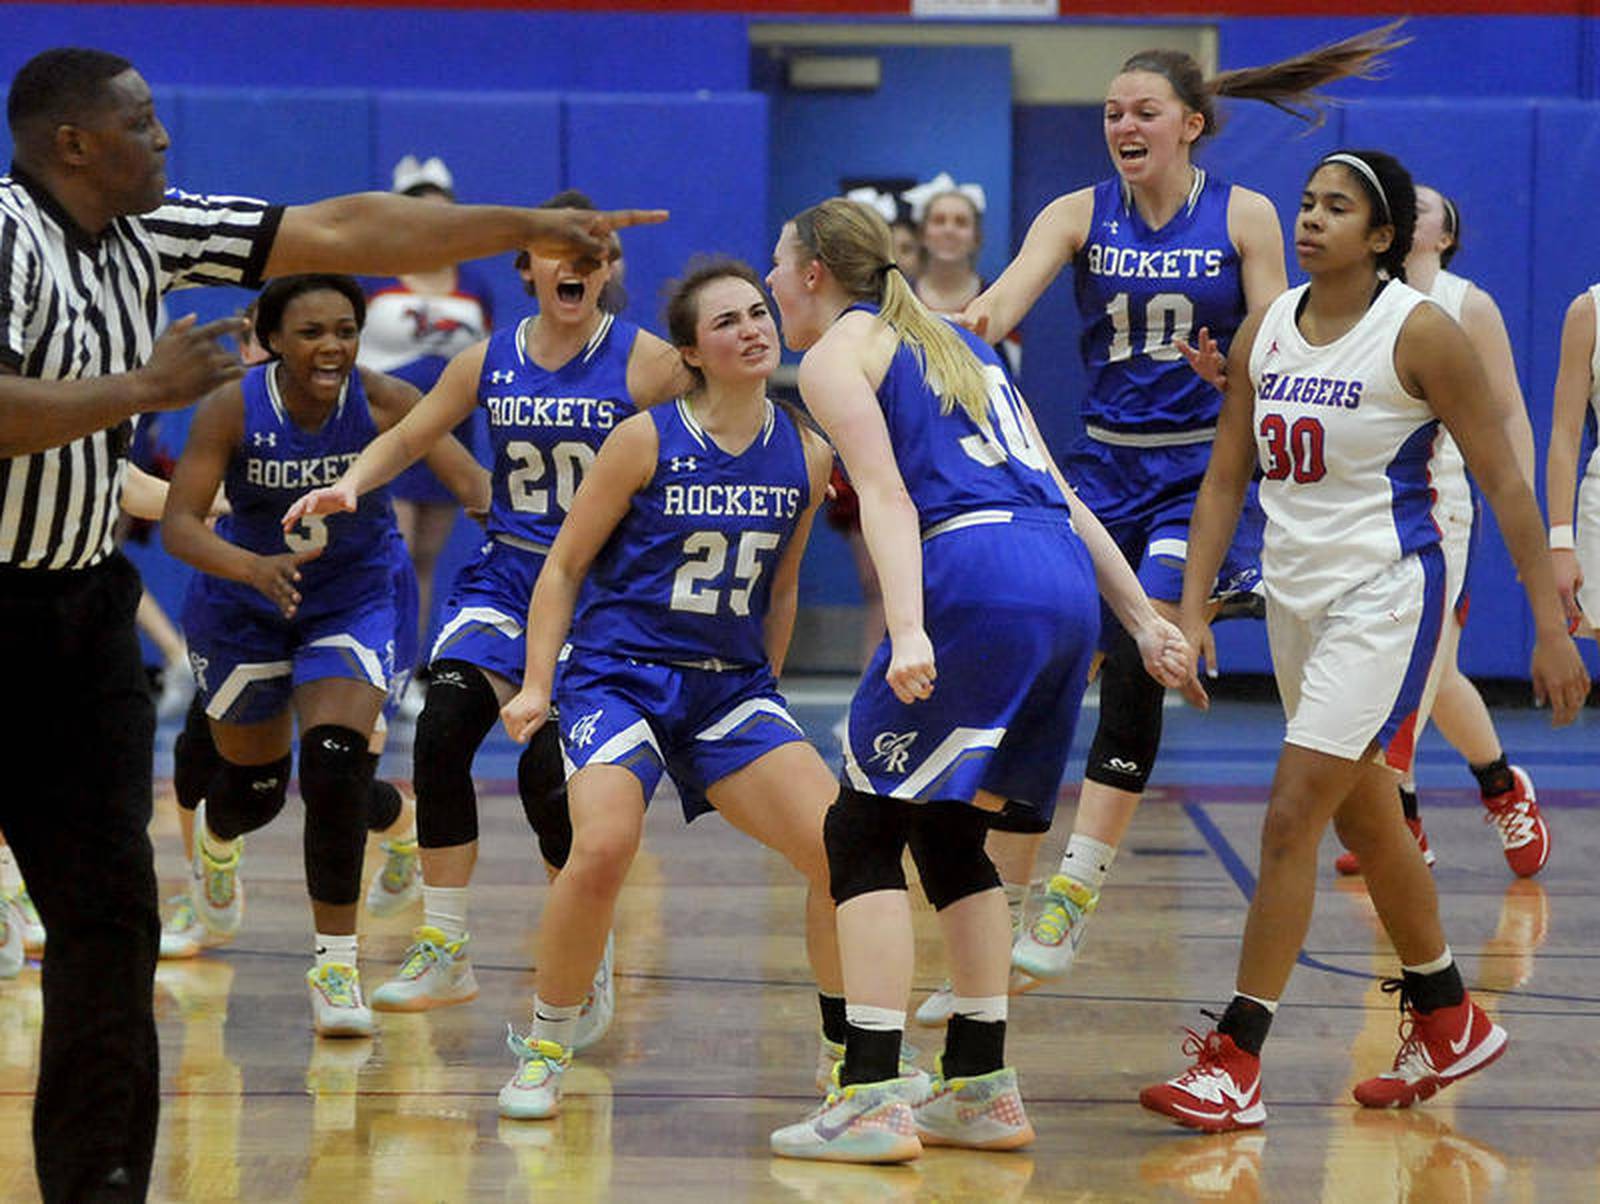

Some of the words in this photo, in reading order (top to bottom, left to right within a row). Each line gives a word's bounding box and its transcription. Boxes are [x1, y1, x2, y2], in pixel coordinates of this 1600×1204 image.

[1088, 244, 1223, 278] ROCKETS
[1106, 292, 1194, 362] 10
[487, 395, 615, 428] ROCKETS
[506, 441, 597, 514] 20
[1260, 413, 1327, 484] 30
[664, 484, 800, 519] ROCKETS
[670, 531, 781, 616] 25
